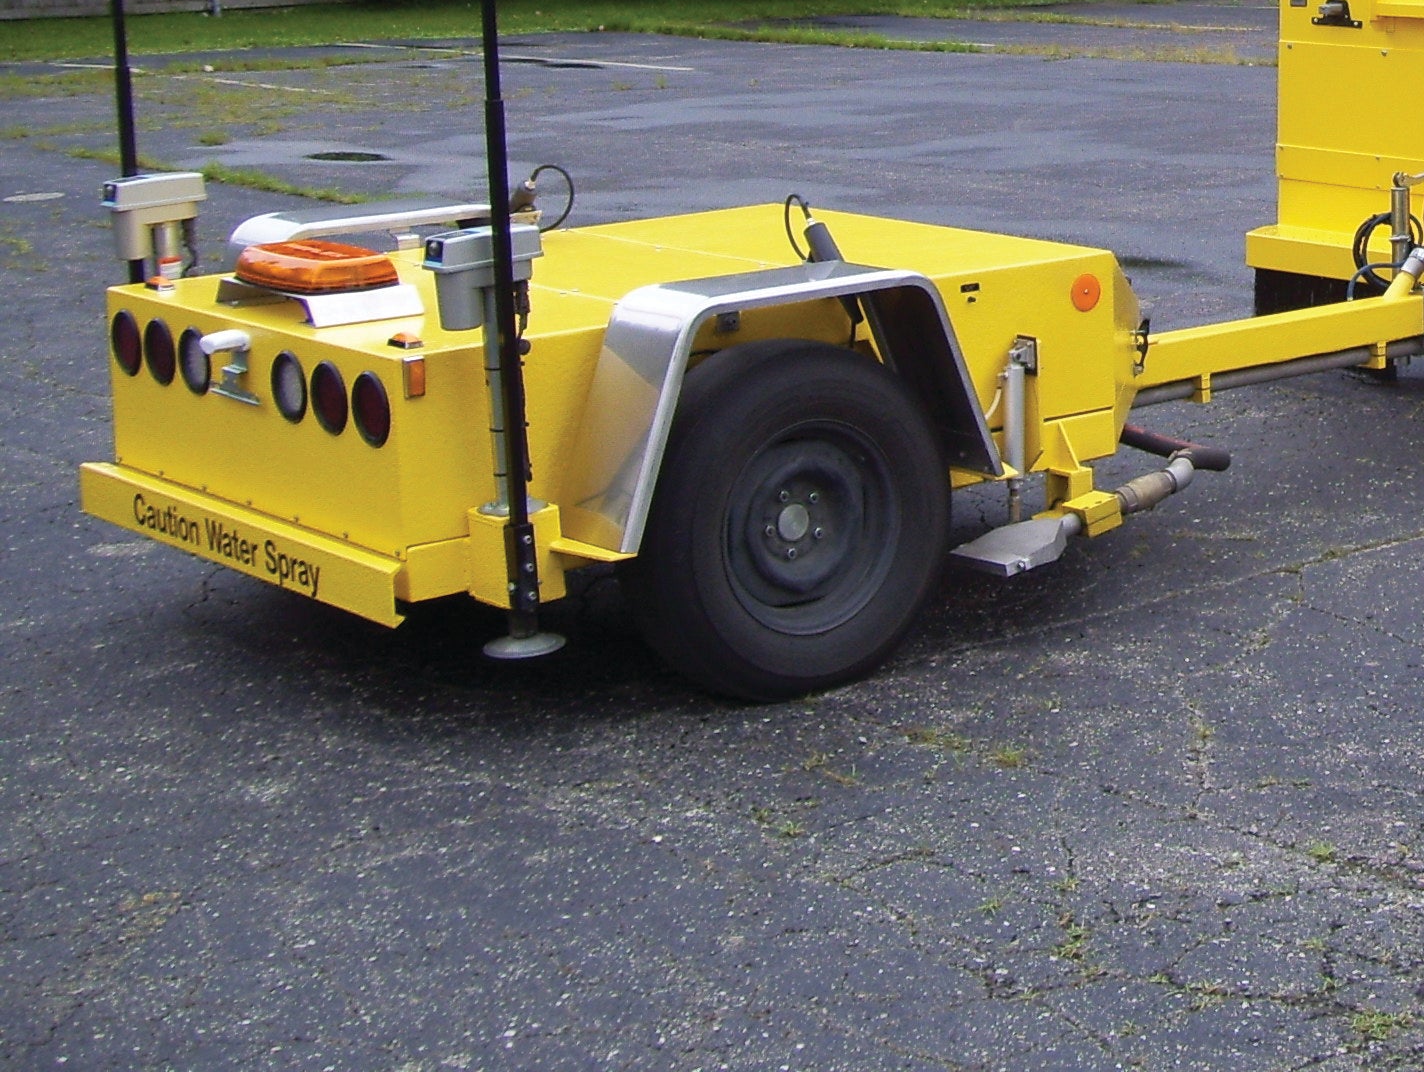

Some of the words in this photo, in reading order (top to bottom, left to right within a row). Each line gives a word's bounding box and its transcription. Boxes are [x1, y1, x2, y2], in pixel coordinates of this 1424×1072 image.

[133, 493, 200, 546] Caution
[204, 518, 258, 567] Water
[264, 539, 320, 598] Spray
